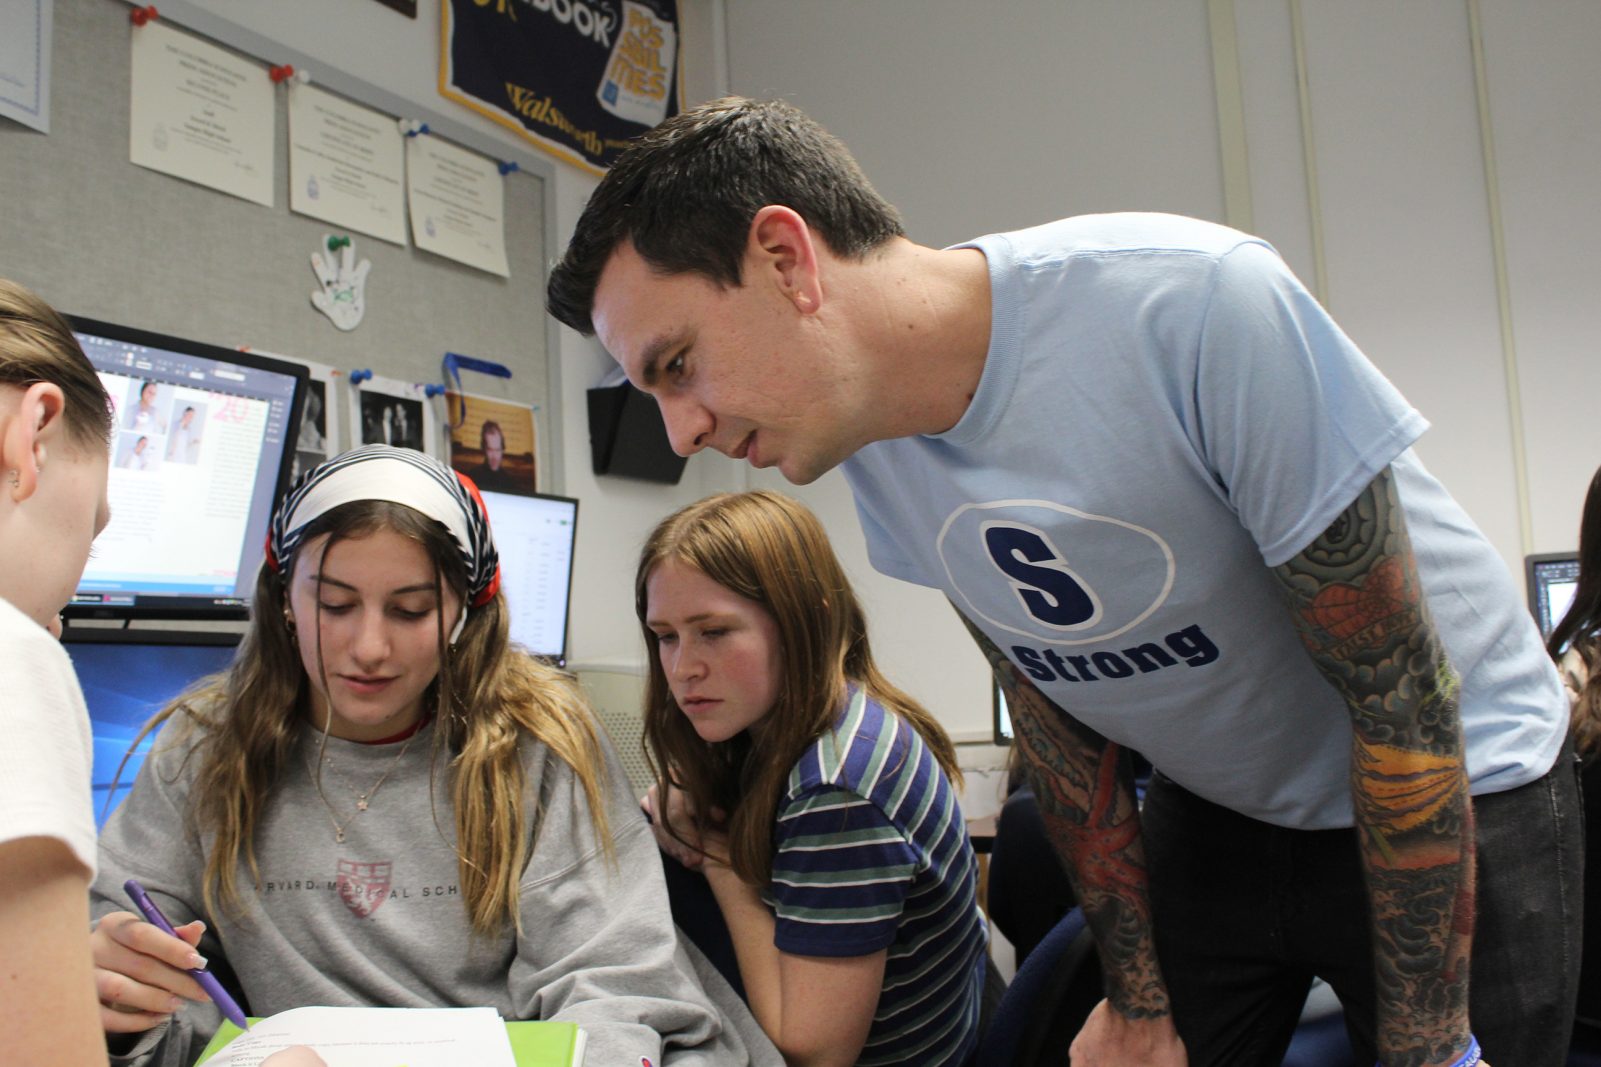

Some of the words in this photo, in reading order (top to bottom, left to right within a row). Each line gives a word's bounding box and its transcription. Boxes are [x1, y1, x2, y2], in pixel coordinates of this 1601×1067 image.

[985, 526, 1095, 626] S
[1010, 623, 1220, 683] Strong
[422, 885, 458, 897] SCH
